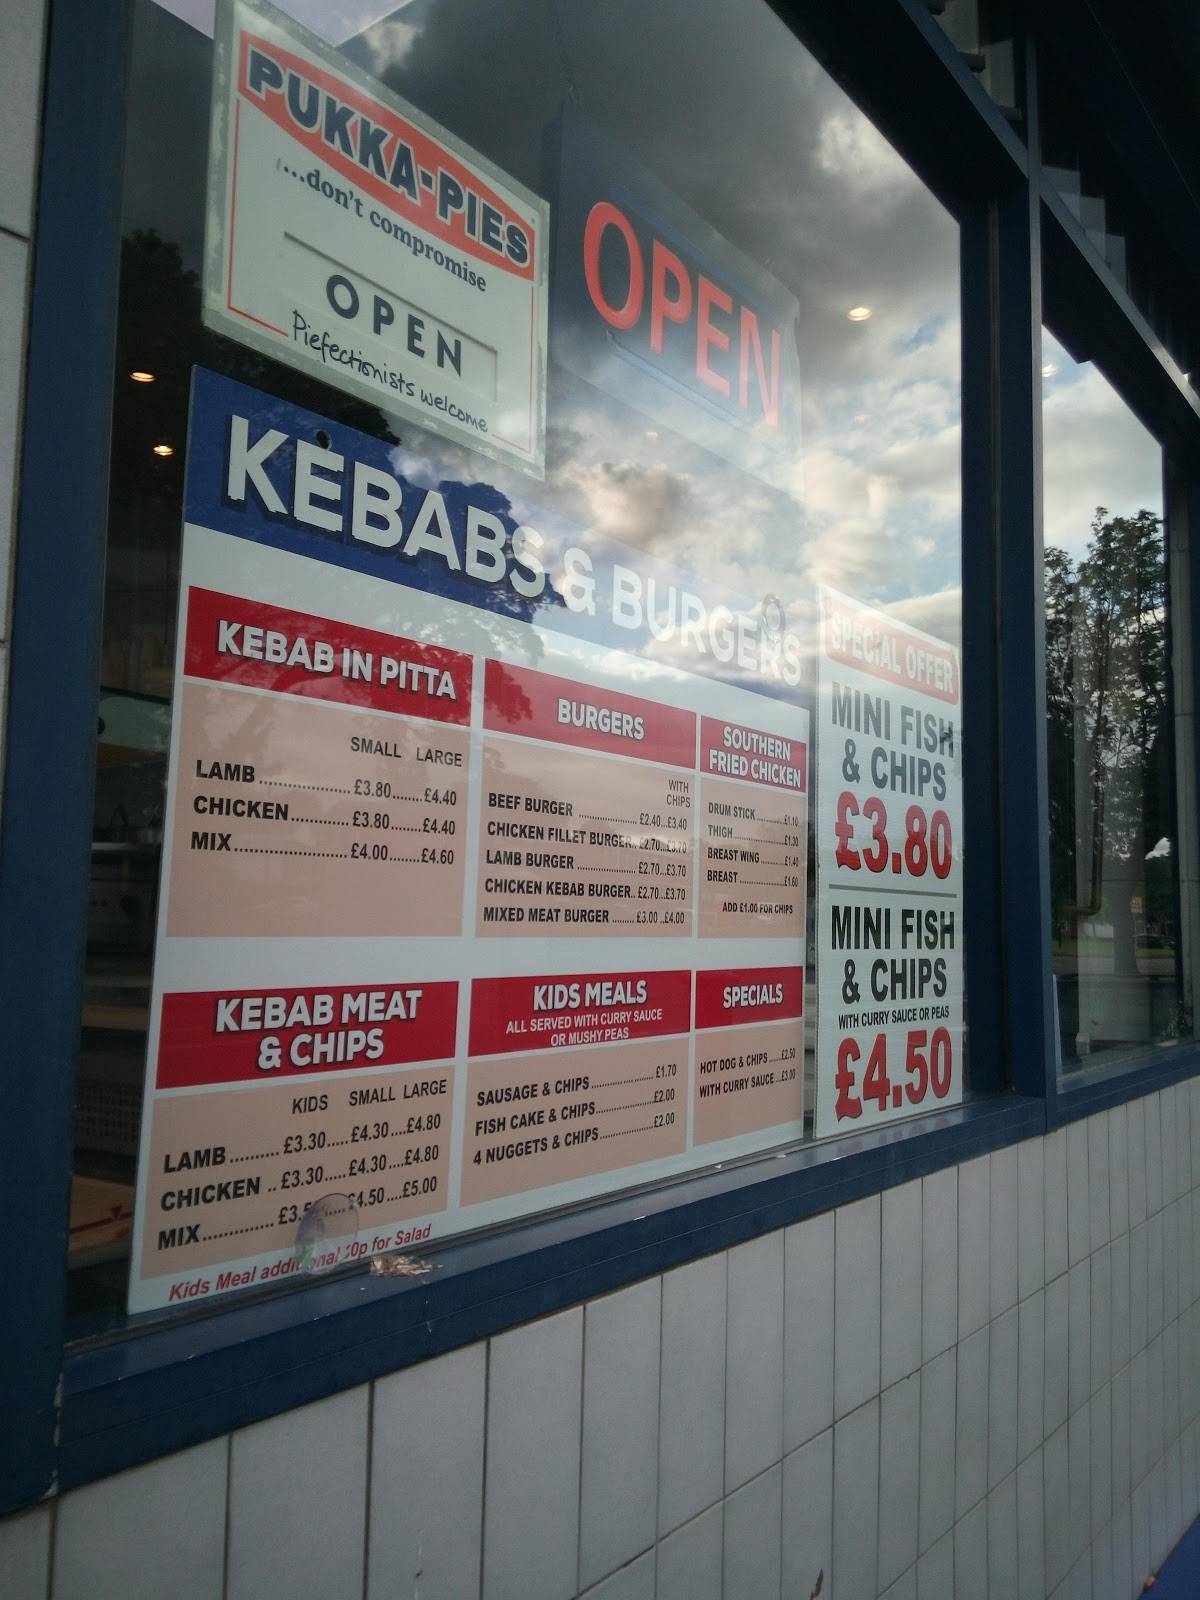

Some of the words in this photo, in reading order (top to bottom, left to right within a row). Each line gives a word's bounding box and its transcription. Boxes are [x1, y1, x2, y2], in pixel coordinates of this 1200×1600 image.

[247, 47, 529, 266] PUKKA-PIES
[369, 210, 487, 292] compromise
[325, 274, 462, 377] OPEN
[583, 202, 781, 427] OPEN
[292, 310, 415, 397] Piefectionists
[420, 387, 489, 433] welcome
[228, 414, 546, 598] KEBABS
[562, 548, 596, 616] &
[612, 564, 801, 686] BURGERS
[217, 620, 334, 674] KEBAB
[342, 648, 372, 682] IN
[380, 657, 456, 699] PITTA
[831, 610, 901, 674] SPECIAL
[906, 651, 953, 693] OFFER
[558, 698, 644, 740] BURGERS
[831, 681, 891, 740] MINI
[901, 705, 954, 758] FISH
[350, 736, 401, 758] SMALL
[416, 747, 462, 767] LARGE
[723, 726, 790, 761] SOUTHERN
[195, 760, 255, 783] LAMB
[354, 779, 391, 798] £3.80
[424, 788, 457, 805] £4.40
[668, 779, 689, 794] WITH
[709, 749, 748, 776] FRIED
[751, 759, 800, 788] CHICKEN
[842, 738, 860, 783] &
[871, 746, 947, 801] CHIPS
[193, 796, 288, 821] CHICKEN
[352, 811, 389, 830] £3.80
[423, 818, 455, 835] £4.40
[489, 793, 520, 810] BEEF
[525, 798, 573, 816] BURGER
[640, 813, 660, 827] £2.40
[668, 819, 687, 830] £3.40
[666, 794, 690, 808] CHIPS
[709, 802, 731, 816] DRUM
[734, 806, 755, 820] STICK
[191, 832, 232, 851] MIX
[351, 843, 388, 861] £4.00
[421, 848, 454, 864] £4.60
[488, 821, 544, 840] CHICKEN
[548, 827, 586, 844] FILLET
[590, 832, 632, 848] BURGER
[708, 825, 733, 838] THIGH
[835, 791, 952, 879] £3.80
[486, 850, 521, 865] LAMB
[526, 852, 574, 869] BURGER
[639, 862, 660, 876] £2.70
[667, 864, 686, 877] £3.70
[708, 848, 738, 861] BREAST
[741, 850, 760, 863] WING
[485, 878, 541, 894] CHICKEN
[546, 881, 584, 896] KEBAB
[588, 884, 630, 898] BURGER
[638, 886, 659, 899] £2.70
[666, 888, 685, 900] £3.70
[707, 870, 738, 883] BREAST
[484, 907, 524, 922] MIXED
[528, 908, 560, 922] MEAT
[564, 909, 609, 923] BURGER
[637, 911, 657, 923] £3.00
[665, 912, 685, 924] £4.00
[723, 902, 737, 912] ADD
[740, 903, 757, 912] £1.00
[760, 904, 773, 913] FOR
[775, 904, 793, 914] CHIPS
[831, 905, 890, 949] MINI
[902, 909, 954, 949] FISH
[533, 984, 580, 1011] KIDS
[585, 980, 647, 1007] MEALS
[723, 984, 783, 1008] SPECIALS
[842, 959, 861, 1004] &
[871, 958, 947, 1002] CHIPS
[216, 994, 333, 1033] KEBAB
[341, 990, 422, 1024] MEAT
[506, 1019, 527, 1034] ALL
[530, 1017, 571, 1031] SERVED
[574, 1014, 597, 1028] WITH
[600, 1011, 631, 1024] CURRY
[634, 1009, 662, 1022] SAUCE
[838, 1013, 859, 1030] WITH
[862, 1010, 889, 1027] CURRY
[892, 1008, 917, 1023] SAUCE
[919, 1008, 929, 1020] OR
[932, 1006, 950, 1019] PEAS
[258, 1036, 281, 1070] &
[290, 1028, 384, 1067] CHIPS
[551, 1034, 565, 1047] OR
[569, 1030, 602, 1044] MUSHY
[604, 1028, 629, 1041] PEAS
[700, 1061, 717, 1074] HOT
[720, 1058, 736, 1071] DOG
[739, 1056, 744, 1068] &
[747, 1052, 767, 1066] CHIPS
[835, 1026, 952, 1122] £4.50
[292, 1095, 328, 1115] KIDS
[349, 1086, 396, 1107] SMALL
[403, 1079, 447, 1099] LARGE
[477, 1083, 538, 1107] SAUSAGE
[543, 1083, 550, 1096] &
[555, 1077, 590, 1094] CHIPS
[656, 1064, 676, 1079] £1.70
[700, 1083, 720, 1098] WITH
[723, 1078, 749, 1093] CURRY
[751, 1073, 774, 1088] SAUCE
[782, 1069, 795, 1081] £3.00
[475, 1117, 506, 1136] FISH
[510, 1111, 544, 1130] CAKE
[549, 1109, 556, 1122] &
[561, 1102, 595, 1120] CHIPS
[654, 1088, 675, 1103] £2.00
[163, 1147, 226, 1173] LAMB
[284, 1132, 326, 1154] £3.30
[352, 1122, 388, 1143] £4.30
[407, 1114, 440, 1134] £4.80
[473, 1151, 481, 1165] 4
[486, 1138, 547, 1164] NUGGETS
[552, 1135, 560, 1149] &
[564, 1128, 599, 1146] CHIPS
[654, 1112, 675, 1127] £2.00
[161, 1177, 261, 1211] CHICKEN
[281, 1166, 323, 1189] £3.30
[349, 1155, 386, 1177] £4.30
[405, 1145, 439, 1165] £4.80
[158, 1224, 201, 1249] MIX
[403, 1177, 437, 1198] £5.00
[169, 1281, 210, 1301] Kids
[216, 1265, 255, 1289] Meal
[372, 1235, 392, 1252] for
[396, 1224, 432, 1245] Salad
